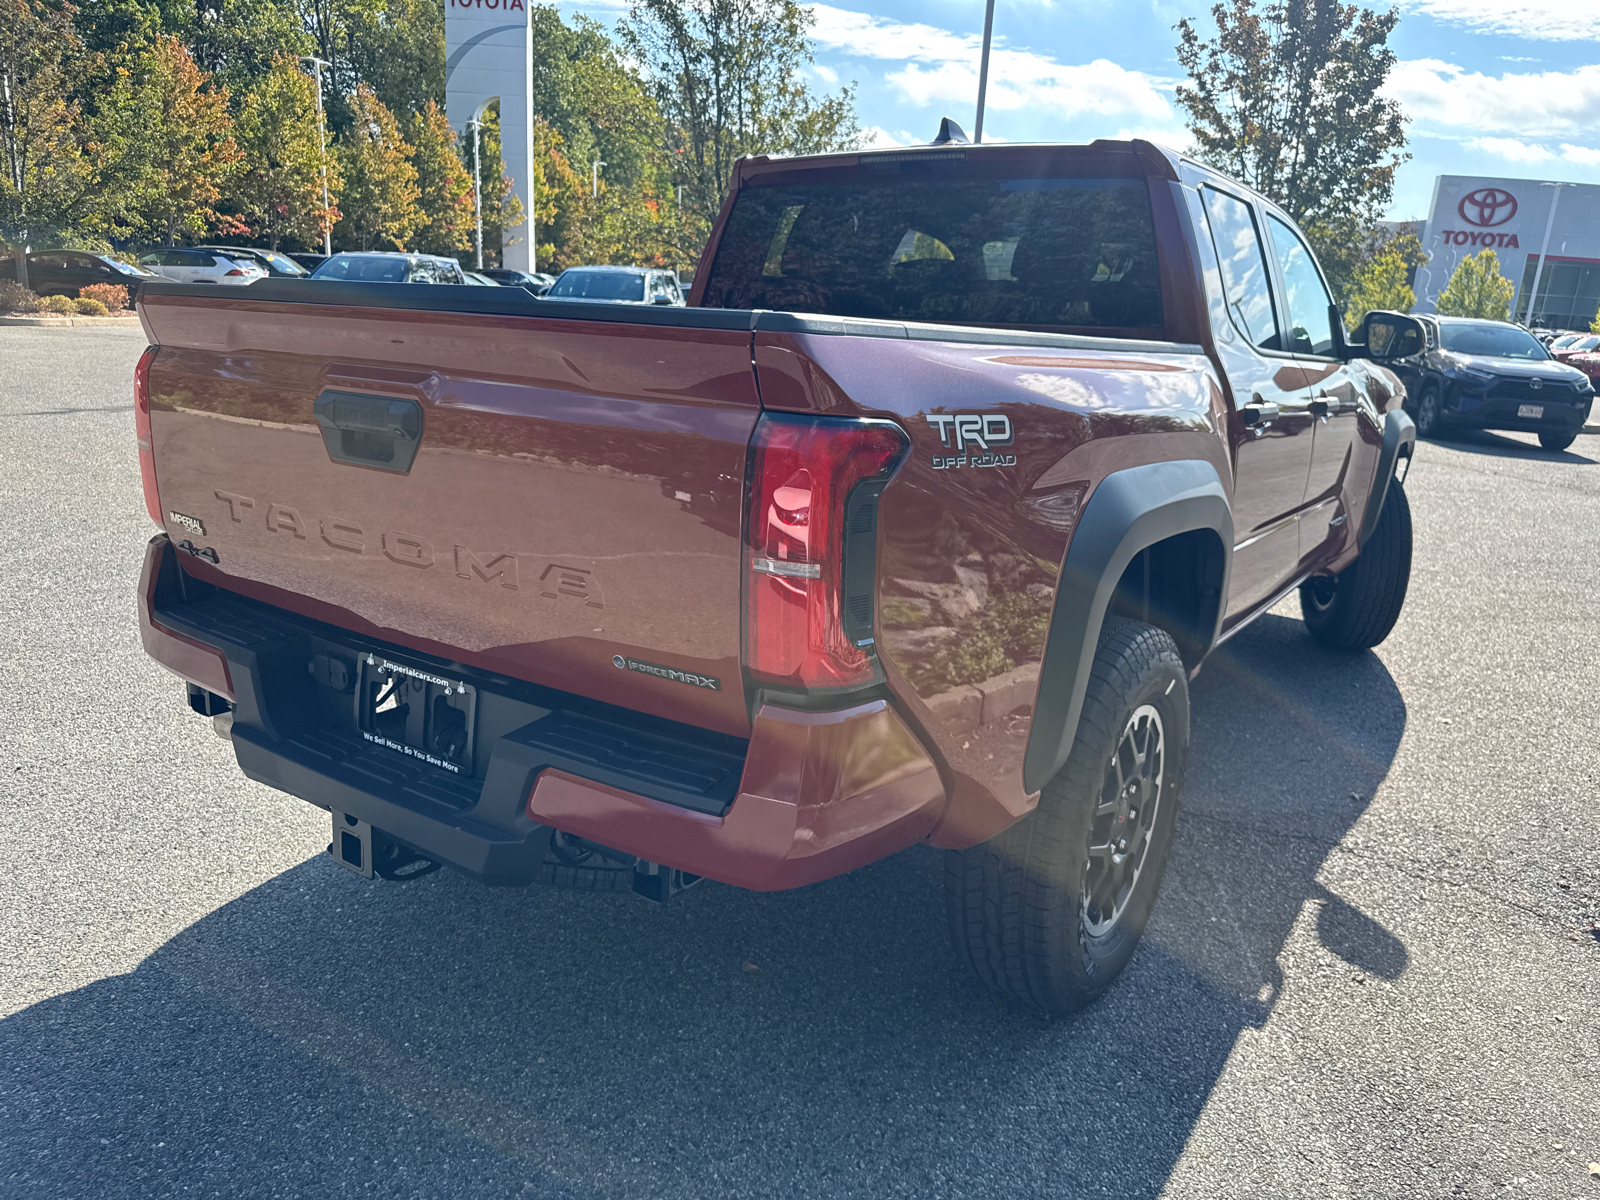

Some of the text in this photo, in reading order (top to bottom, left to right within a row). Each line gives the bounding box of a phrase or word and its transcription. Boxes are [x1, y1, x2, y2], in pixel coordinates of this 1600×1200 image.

[1442, 230, 1519, 249] TOYOTA
[925, 414, 1014, 456] TRD
[931, 453, 1017, 470] OFF ROAD
[214, 489, 605, 610] TACOMA
[383, 660, 449, 687] Imperialcars.com
[363, 732, 374, 742] We
[374, 737, 386, 746] Sell
[404, 746, 413, 756] So
[413, 749, 426, 760] You
[426, 754, 442, 767] Save
[442, 759, 459, 773] More
